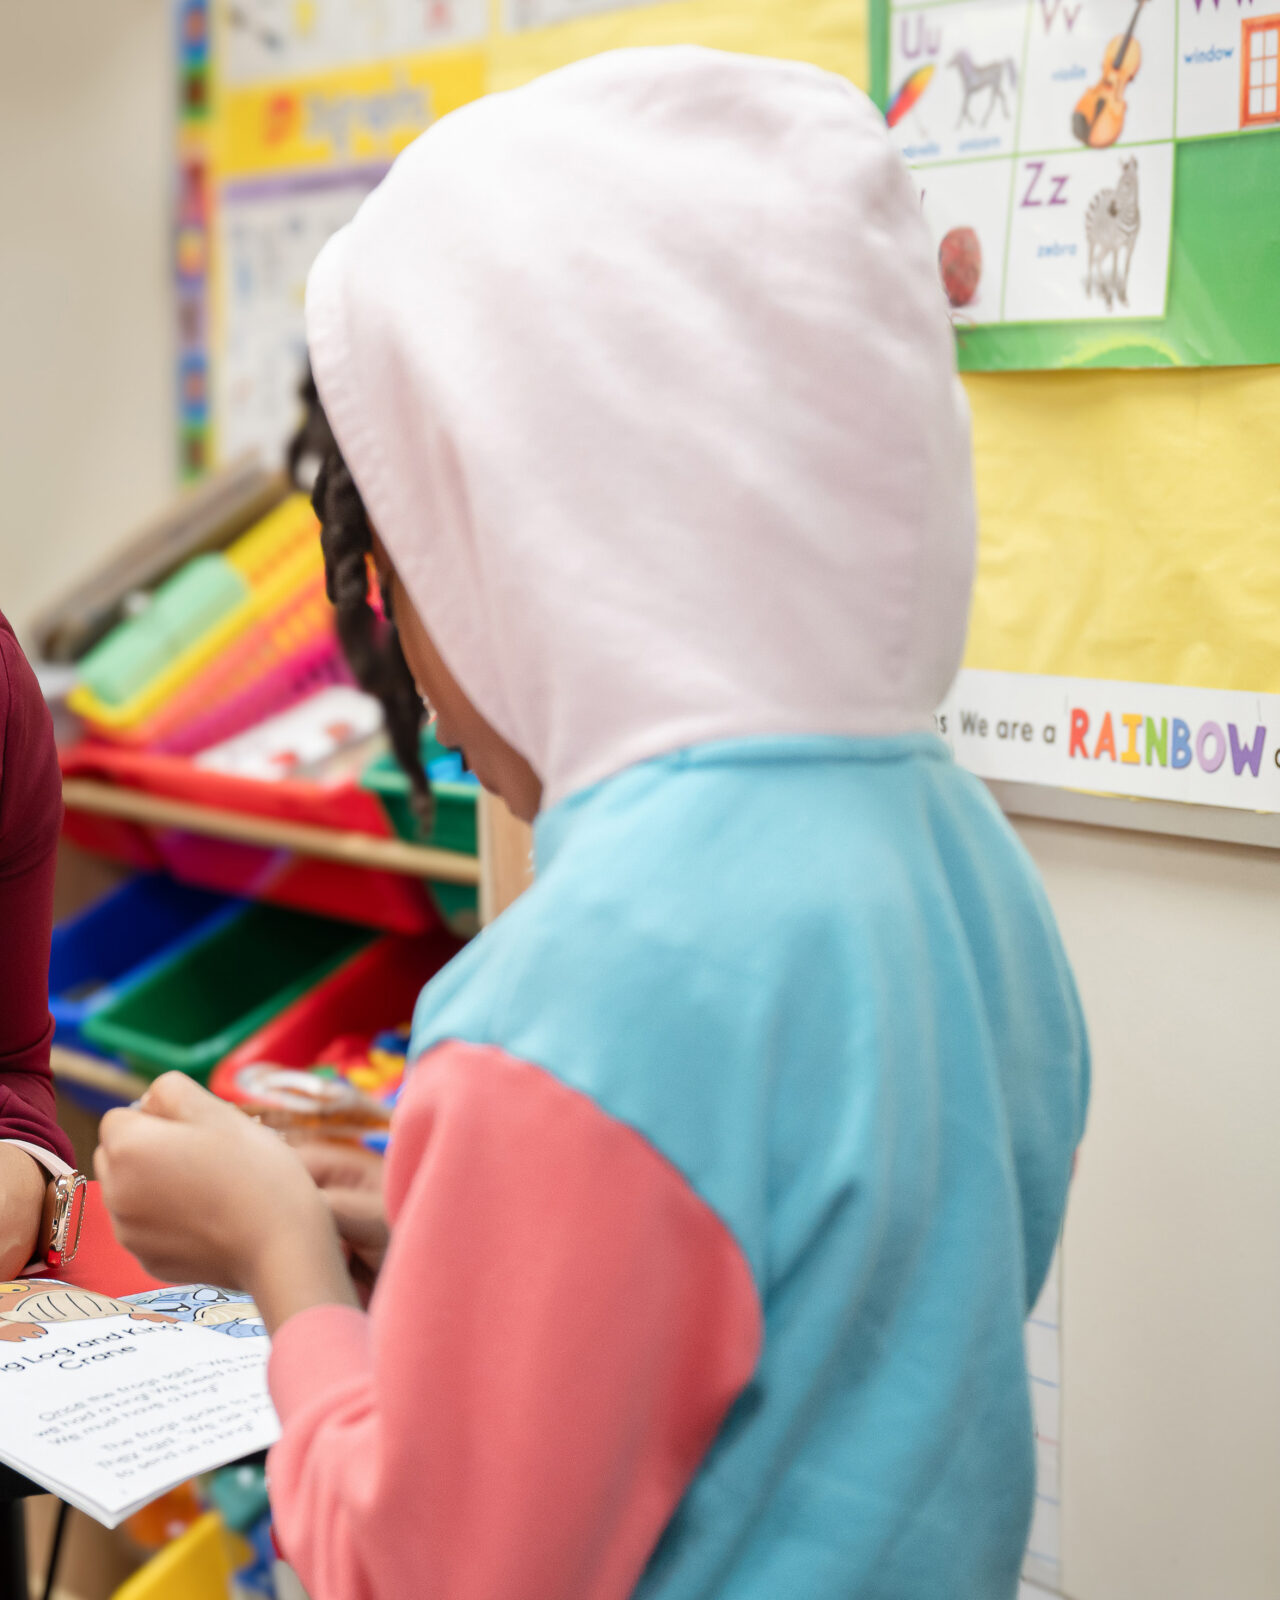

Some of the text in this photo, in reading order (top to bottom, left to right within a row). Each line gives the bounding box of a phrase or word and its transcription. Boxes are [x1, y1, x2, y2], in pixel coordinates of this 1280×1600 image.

[1039, 0, 1083, 35] Vv
[901, 16, 940, 58] Uu
[1184, 45, 1234, 64] window
[1021, 161, 1070, 208] Zz
[1037, 242, 1078, 258] zebra
[960, 709, 988, 738] We
[996, 719, 1033, 742] are
[1042, 724, 1057, 745] a
[1068, 707, 1267, 778] RAINBOW
[21, 1346, 75, 1364] Log
[76, 1332, 124, 1349] and
[122, 1323, 183, 1336] King
[58, 1345, 138, 1371] Crane
